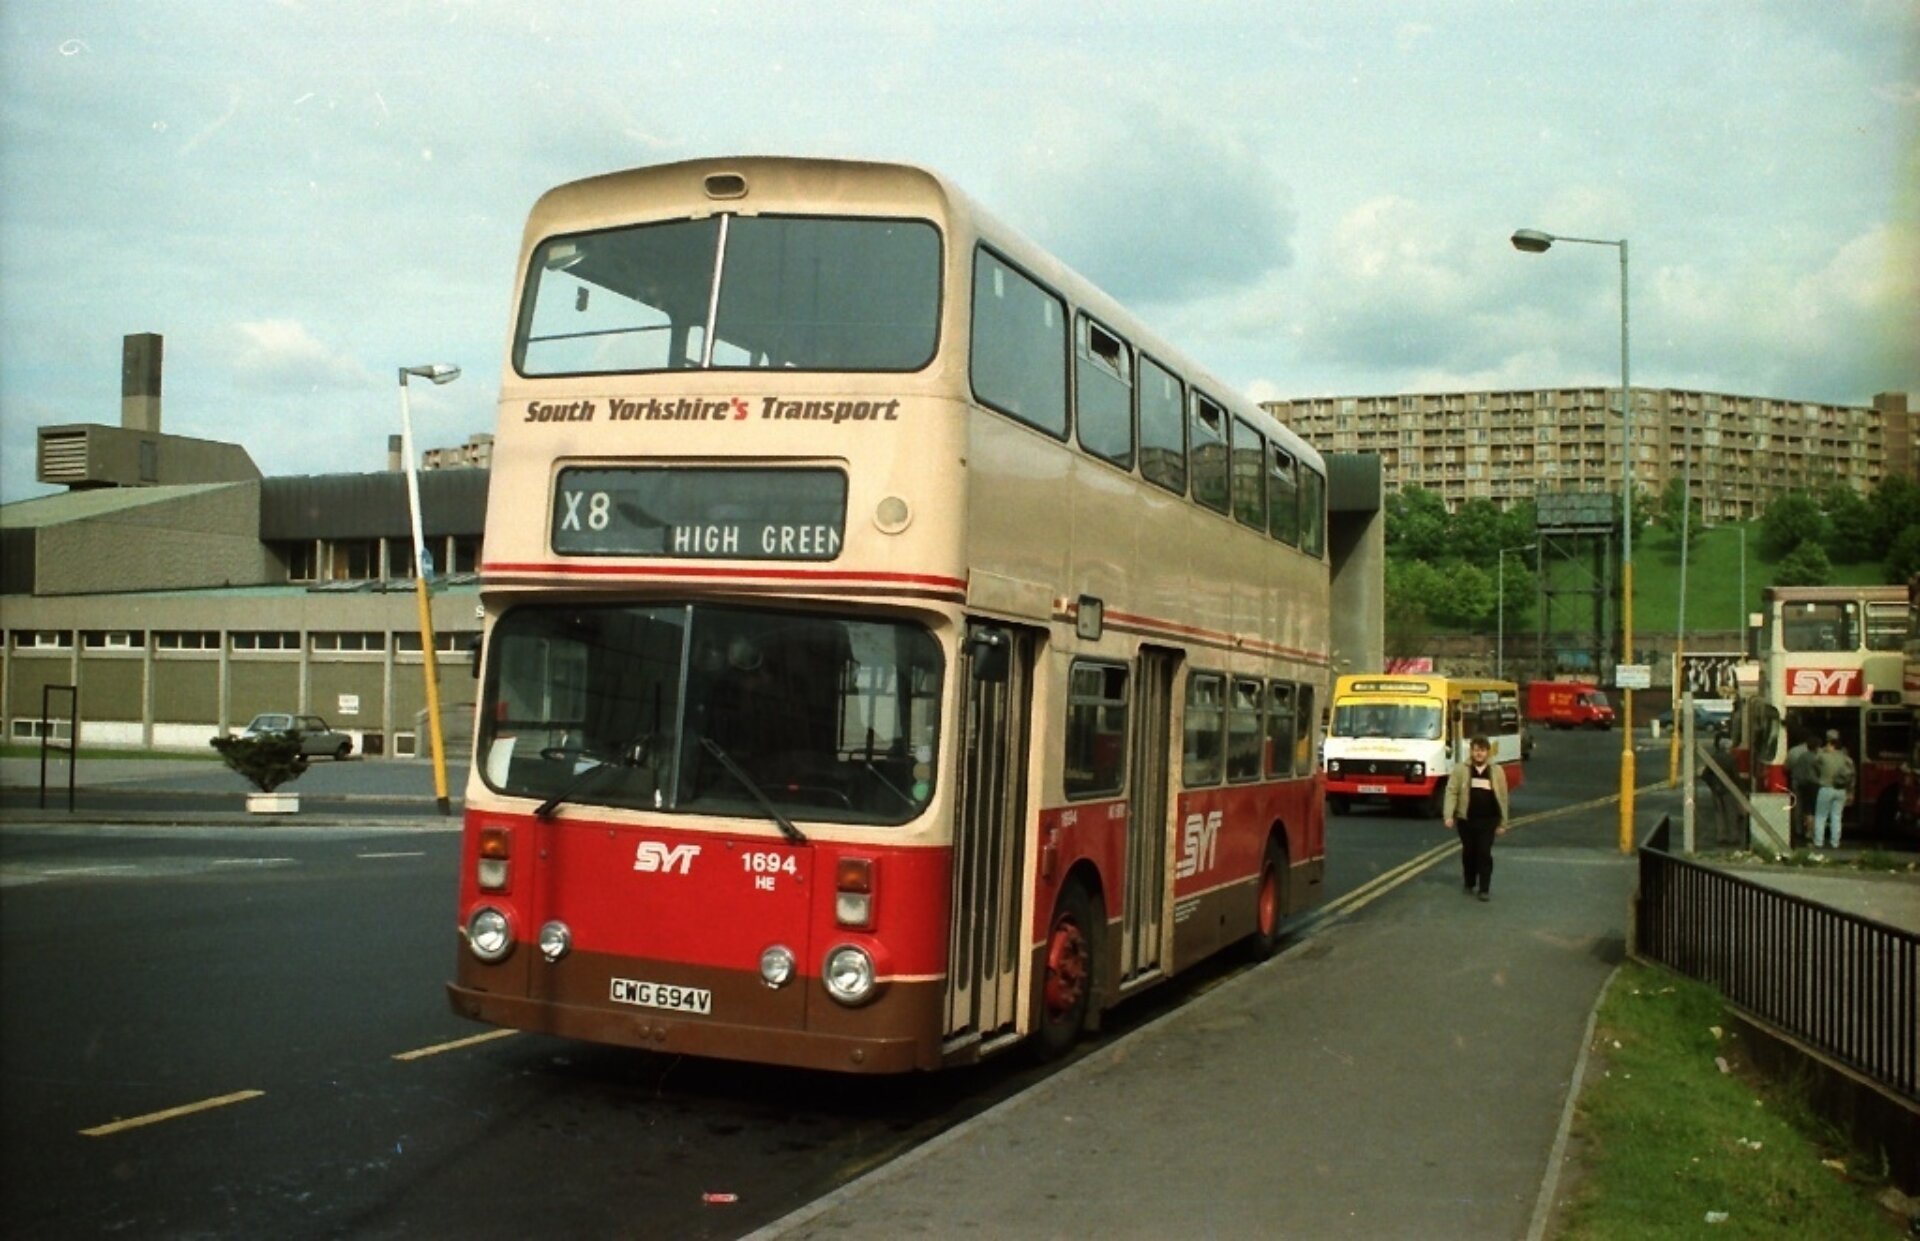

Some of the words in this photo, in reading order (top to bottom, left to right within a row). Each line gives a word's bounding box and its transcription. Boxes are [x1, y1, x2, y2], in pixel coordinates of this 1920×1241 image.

[524, 399, 595, 422] South
[608, 397, 749, 421] Yorkshire's
[760, 397, 900, 424] Transport
[561, 491, 611, 531] X8
[674, 525, 739, 554] HIGH
[1791, 670, 1858, 695] SYT
[633, 841, 702, 875] SYT
[1176, 810, 1223, 879] SYT
[741, 852, 797, 875] 1694
[755, 876, 776, 891] HE
[611, 979, 652, 1004] CWG
[655, 983, 711, 1011] 694V
